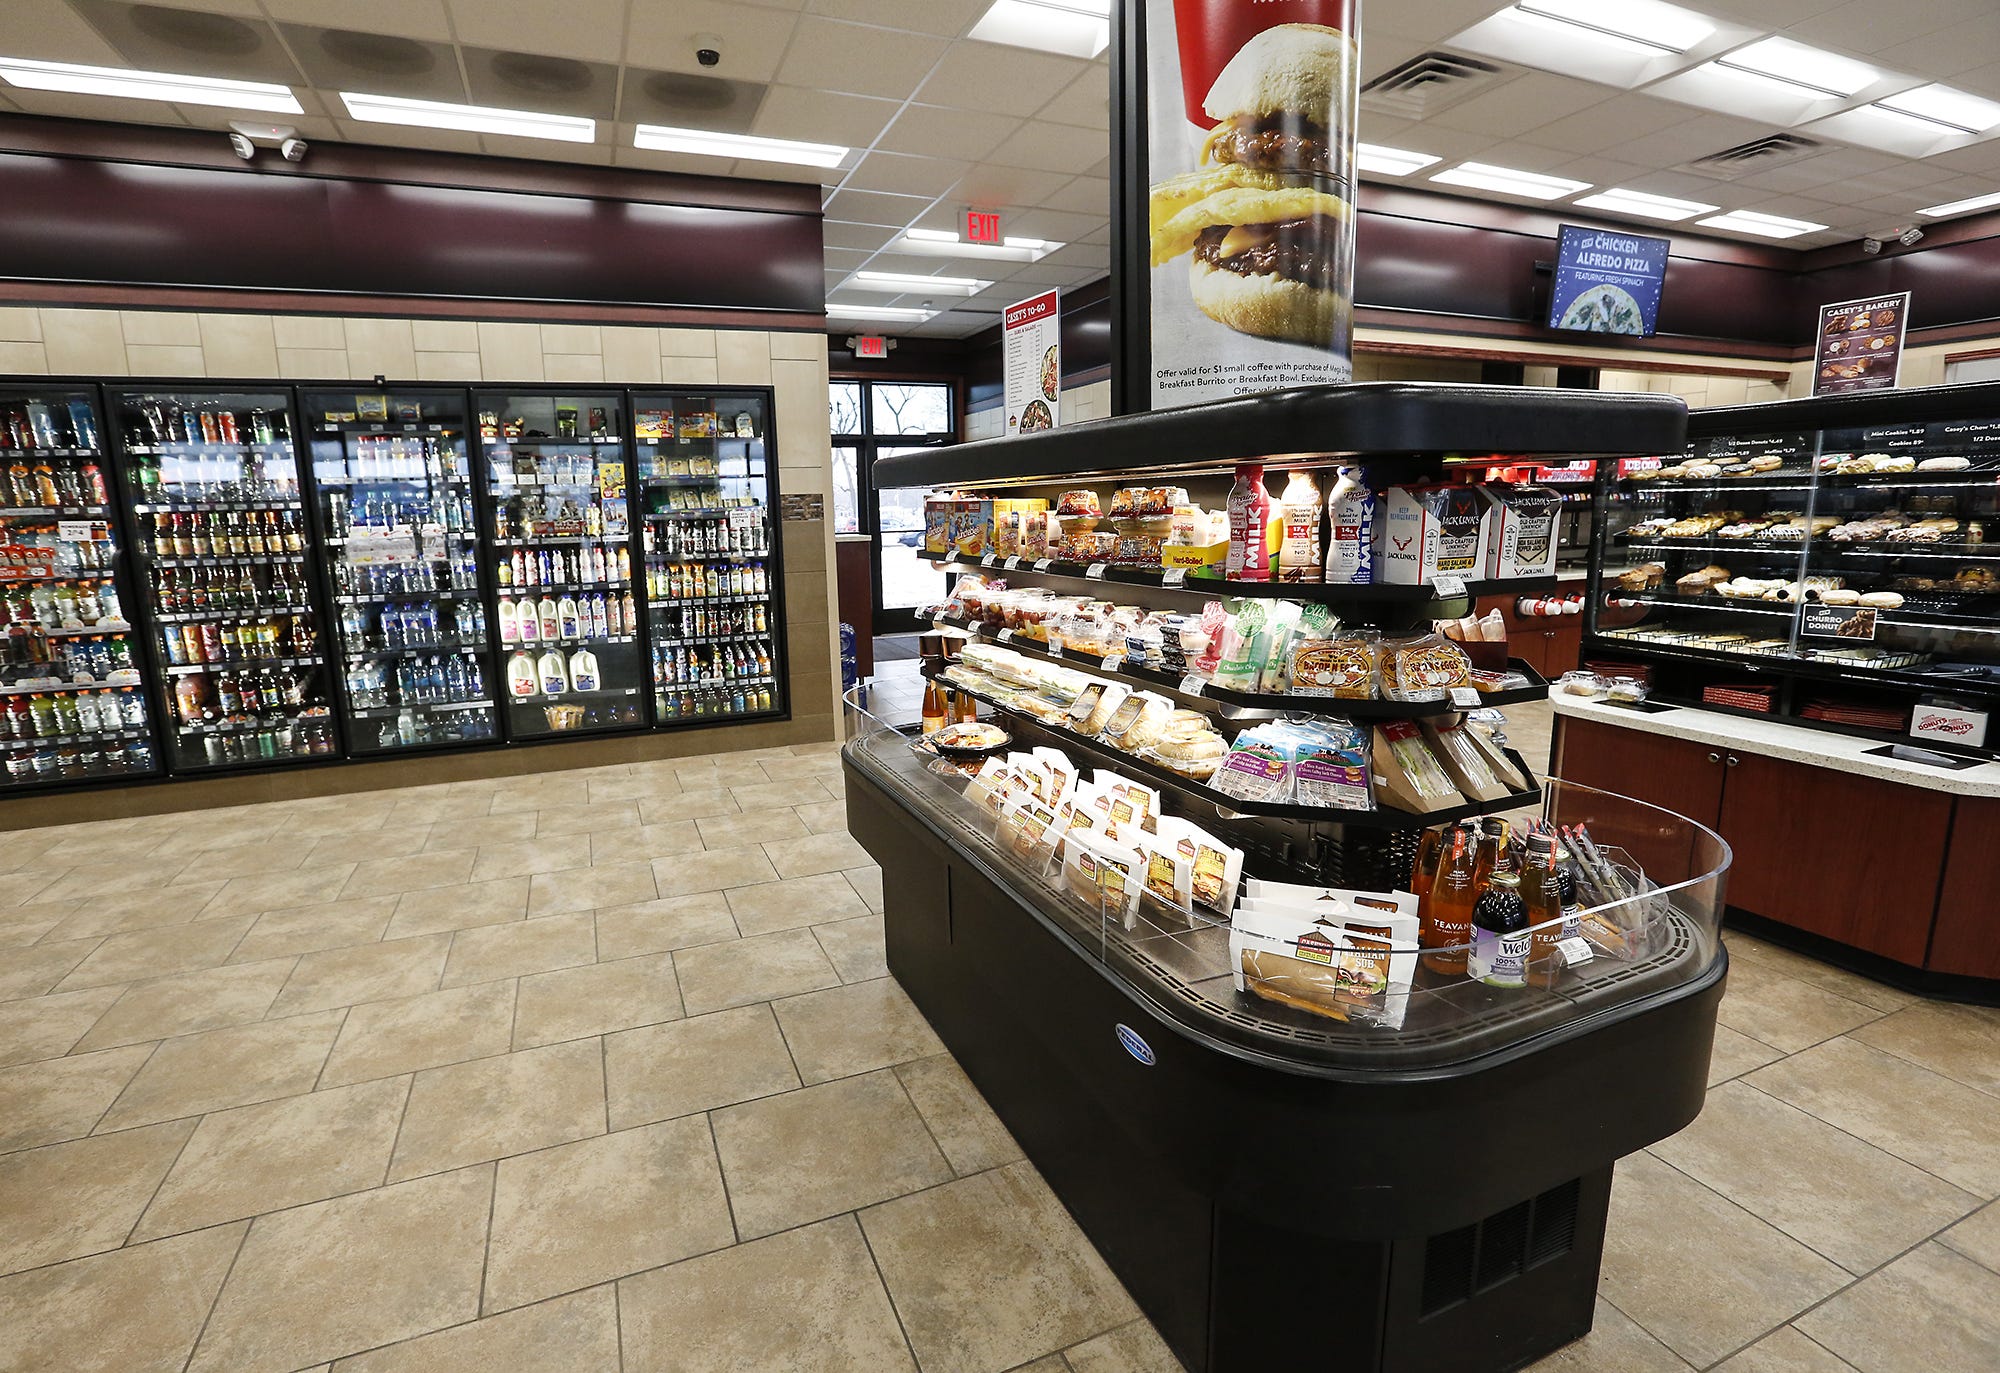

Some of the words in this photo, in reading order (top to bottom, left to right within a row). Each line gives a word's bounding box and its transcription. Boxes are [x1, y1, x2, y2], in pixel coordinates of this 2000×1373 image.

[967, 211, 1000, 242] EXIT
[1595, 235, 1639, 254] CHICKEN
[1576, 252, 1622, 269] ALFREDO
[1624, 258, 1650, 273] PIZZA
[1575, 271, 1604, 282] FEATURING
[1605, 275, 1622, 284] FRESH
[1622, 278, 1644, 287] SPINACH
[1007, 308, 1027, 324] CASEY'S
[1027, 302, 1047, 316] TO-GO
[1827, 305, 1863, 317] CASEY'S
[1865, 299, 1902, 311] BAKERY
[862, 337, 882, 354] EXIT
[1157, 369, 1177, 379] Offer
[1179, 367, 1197, 376] valid
[1199, 366, 1211, 375] for
[1213, 365, 1222, 374] $1
[1224, 363, 1245, 373] small
[1247, 362, 1273, 372] coffee
[1274, 362, 1292, 371] with
[1293, 363, 1322, 375] purchase
[1160, 378, 1195, 390] Breakfast
[1197, 376, 1226, 387] Burrito
[1239, 373, 1278, 384] Breakfast
[1280, 373, 1300, 383] Bowl.
[1301, 374, 1327, 383] Excludes
[1234, 387, 1256, 395] Offer
[1515, 498, 1532, 507] JACK
[1390, 513, 1419, 522] REFRIGERATED
[1442, 517, 1459, 527] JACK
[1245, 506, 1262, 569] MILK
[1311, 504, 1323, 566] MILK
[1361, 502, 1375, 570] MILK
[1446, 543, 1470, 551] LINKWICH
[1173, 556, 1204, 566] Hard-Boiled
[1387, 552, 1401, 561] JACK
[1806, 615, 1843, 624] CHURRO
[1808, 623, 1839, 631] DONUT
[1303, 660, 1330, 673] BACON
[1331, 663, 1338, 672] N
[1441, 660, 1459, 671] EGGS
[1918, 717, 1948, 731] DONUTS
[1433, 918, 1472, 932] TEAVAN
[1563, 928, 1579, 936] 100%
[1355, 957, 1375, 970] SUB
[1495, 957, 1517, 966] 100%
